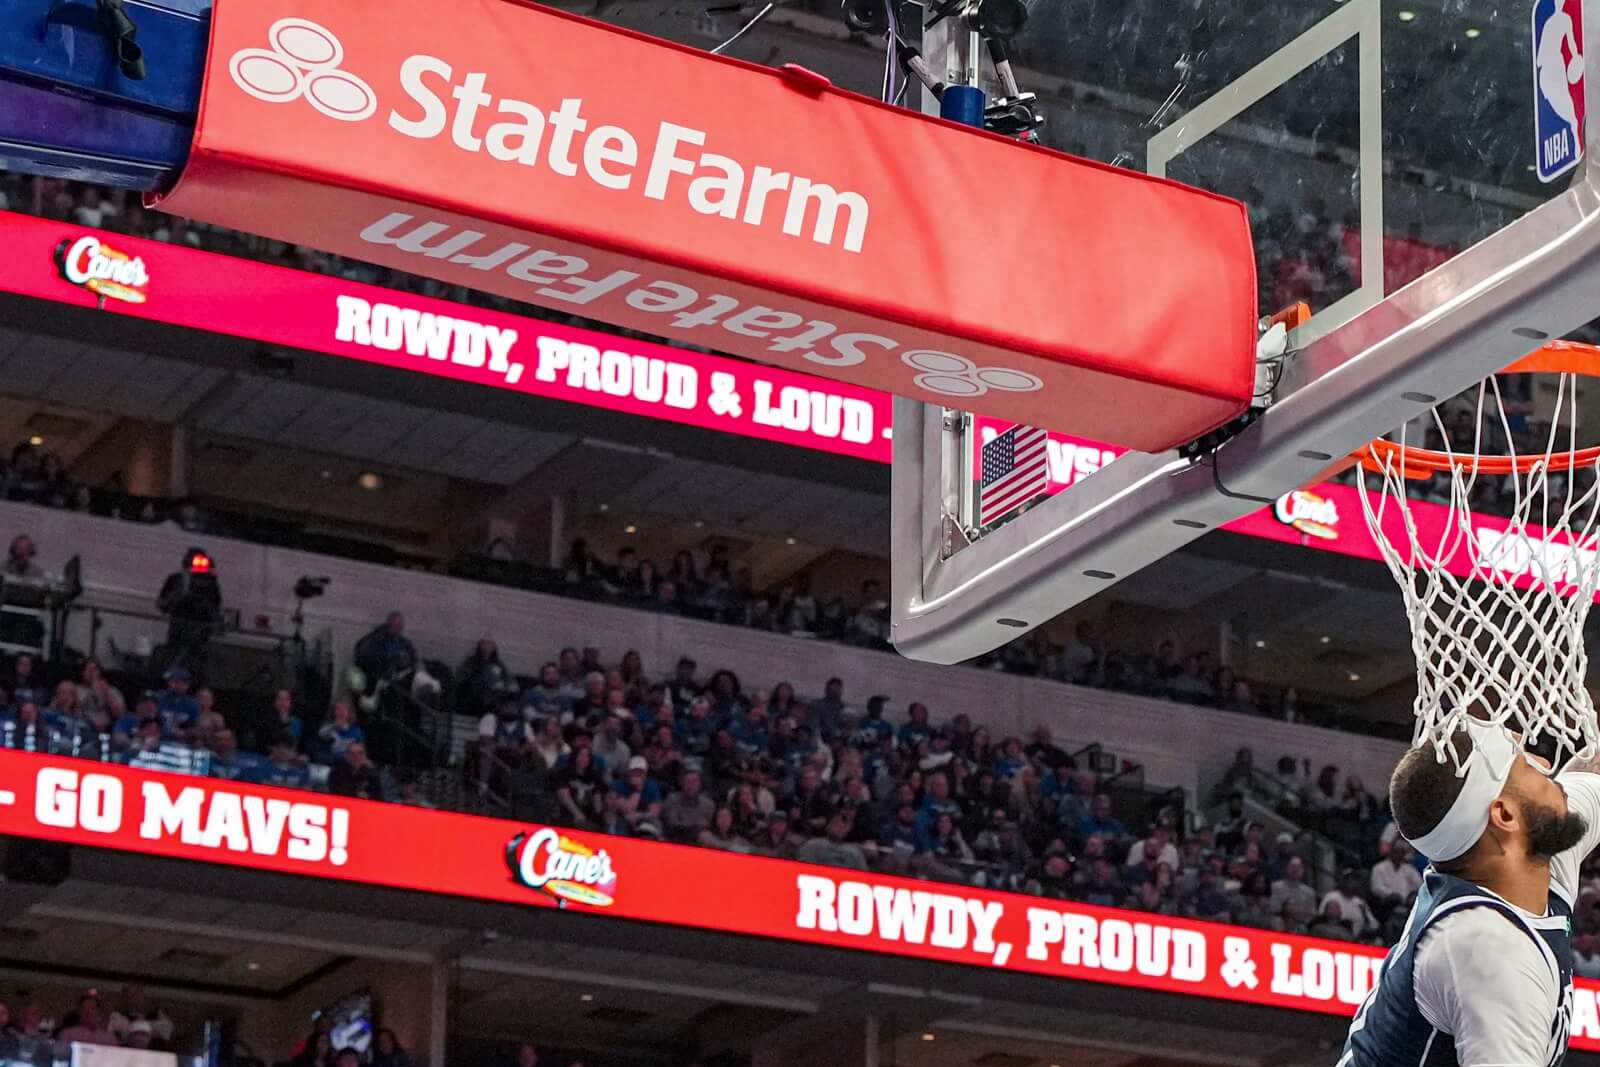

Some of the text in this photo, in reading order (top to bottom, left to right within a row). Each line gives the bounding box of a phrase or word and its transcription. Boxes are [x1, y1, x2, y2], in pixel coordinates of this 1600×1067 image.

[1544, 137, 1571, 169] NBA
[336, 296, 874, 443] ROWDY, PROUD & LOUD
[36, 768, 122, 832] GO
[140, 782, 349, 865] MAVS!
[797, 874, 1011, 966] ROWDY,
[1027, 908, 1207, 982] PROUD
[1221, 937, 1259, 989] &
[1271, 944, 1378, 1005] LOU
